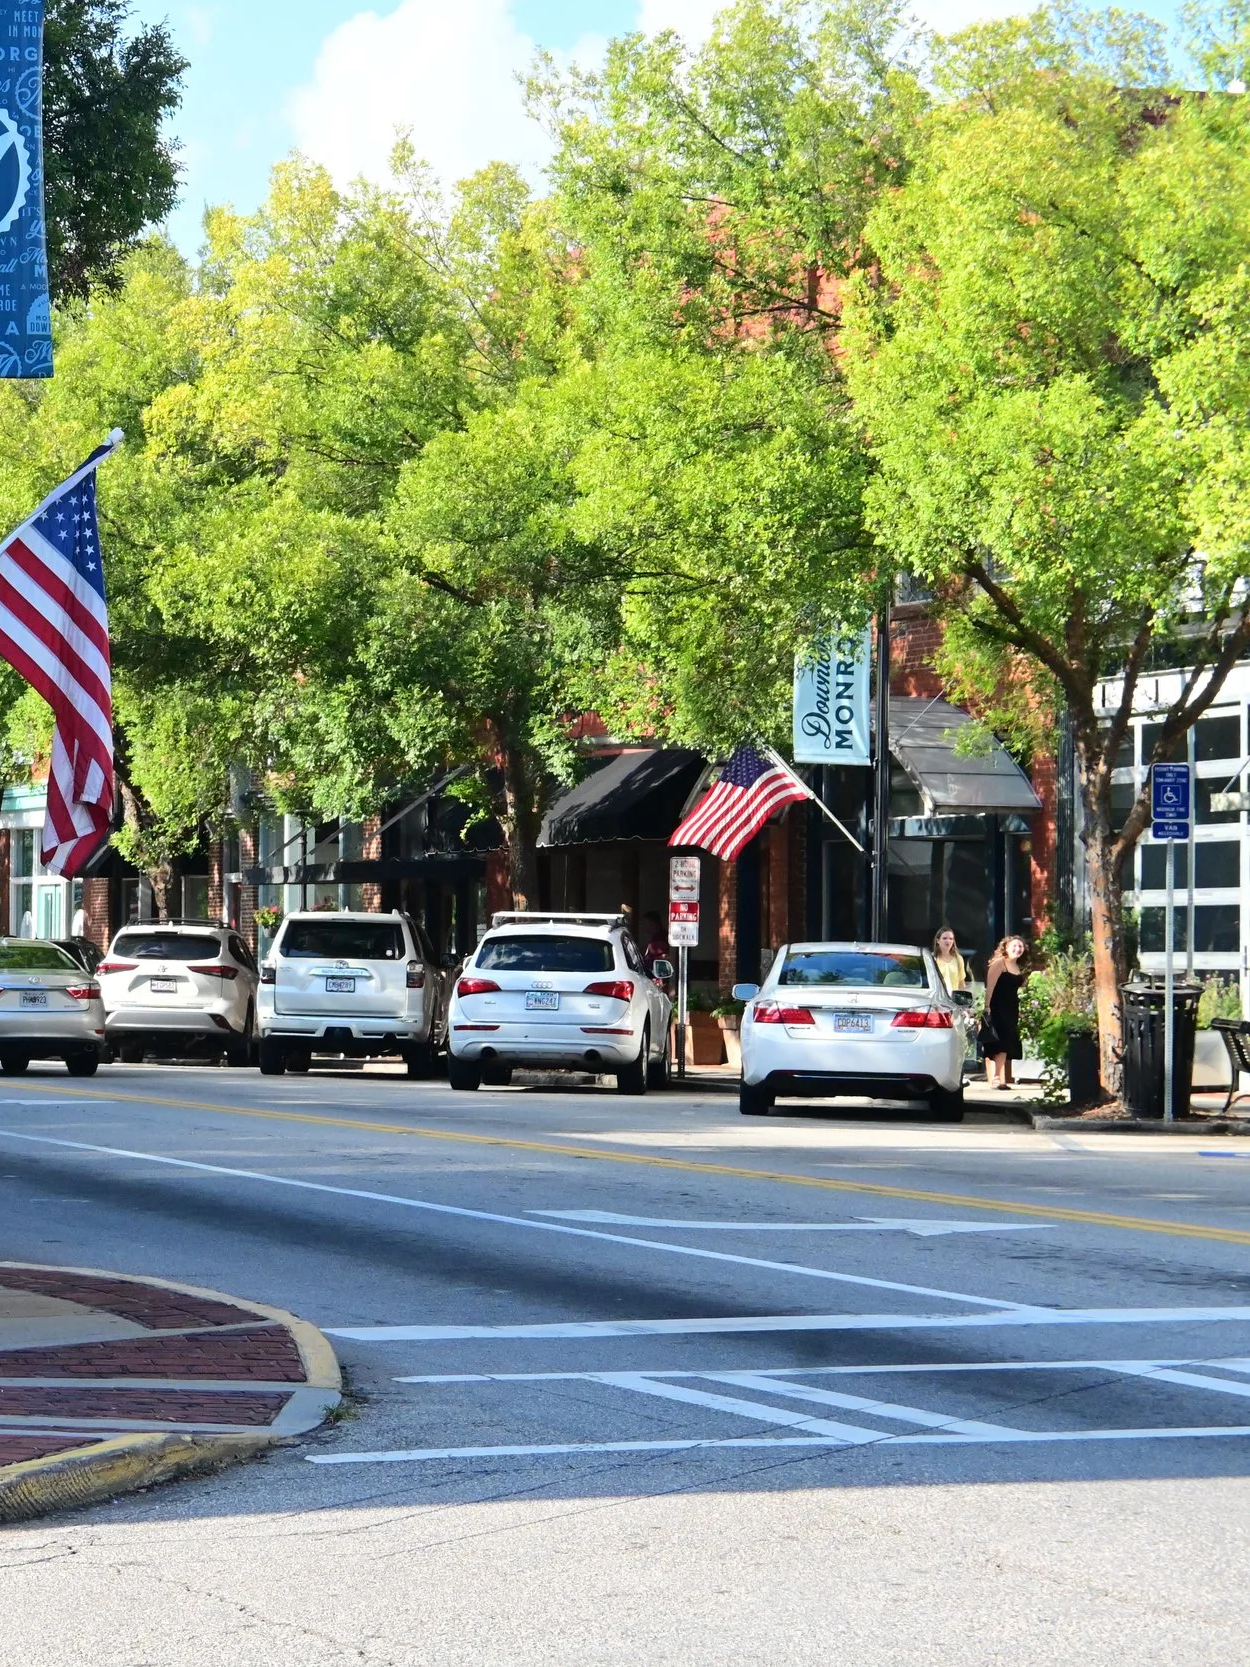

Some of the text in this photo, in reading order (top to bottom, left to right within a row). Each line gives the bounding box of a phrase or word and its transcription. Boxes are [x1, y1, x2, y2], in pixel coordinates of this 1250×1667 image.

[13, 10, 39, 23] MEET
[8, 24, 18, 38] IN
[834, 637, 856, 750] MONRO
[674, 860, 679, 868] 2
[673, 870, 697, 878] PARKING
[679, 903, 689, 912] NO
[671, 912, 697, 921] PARKING
